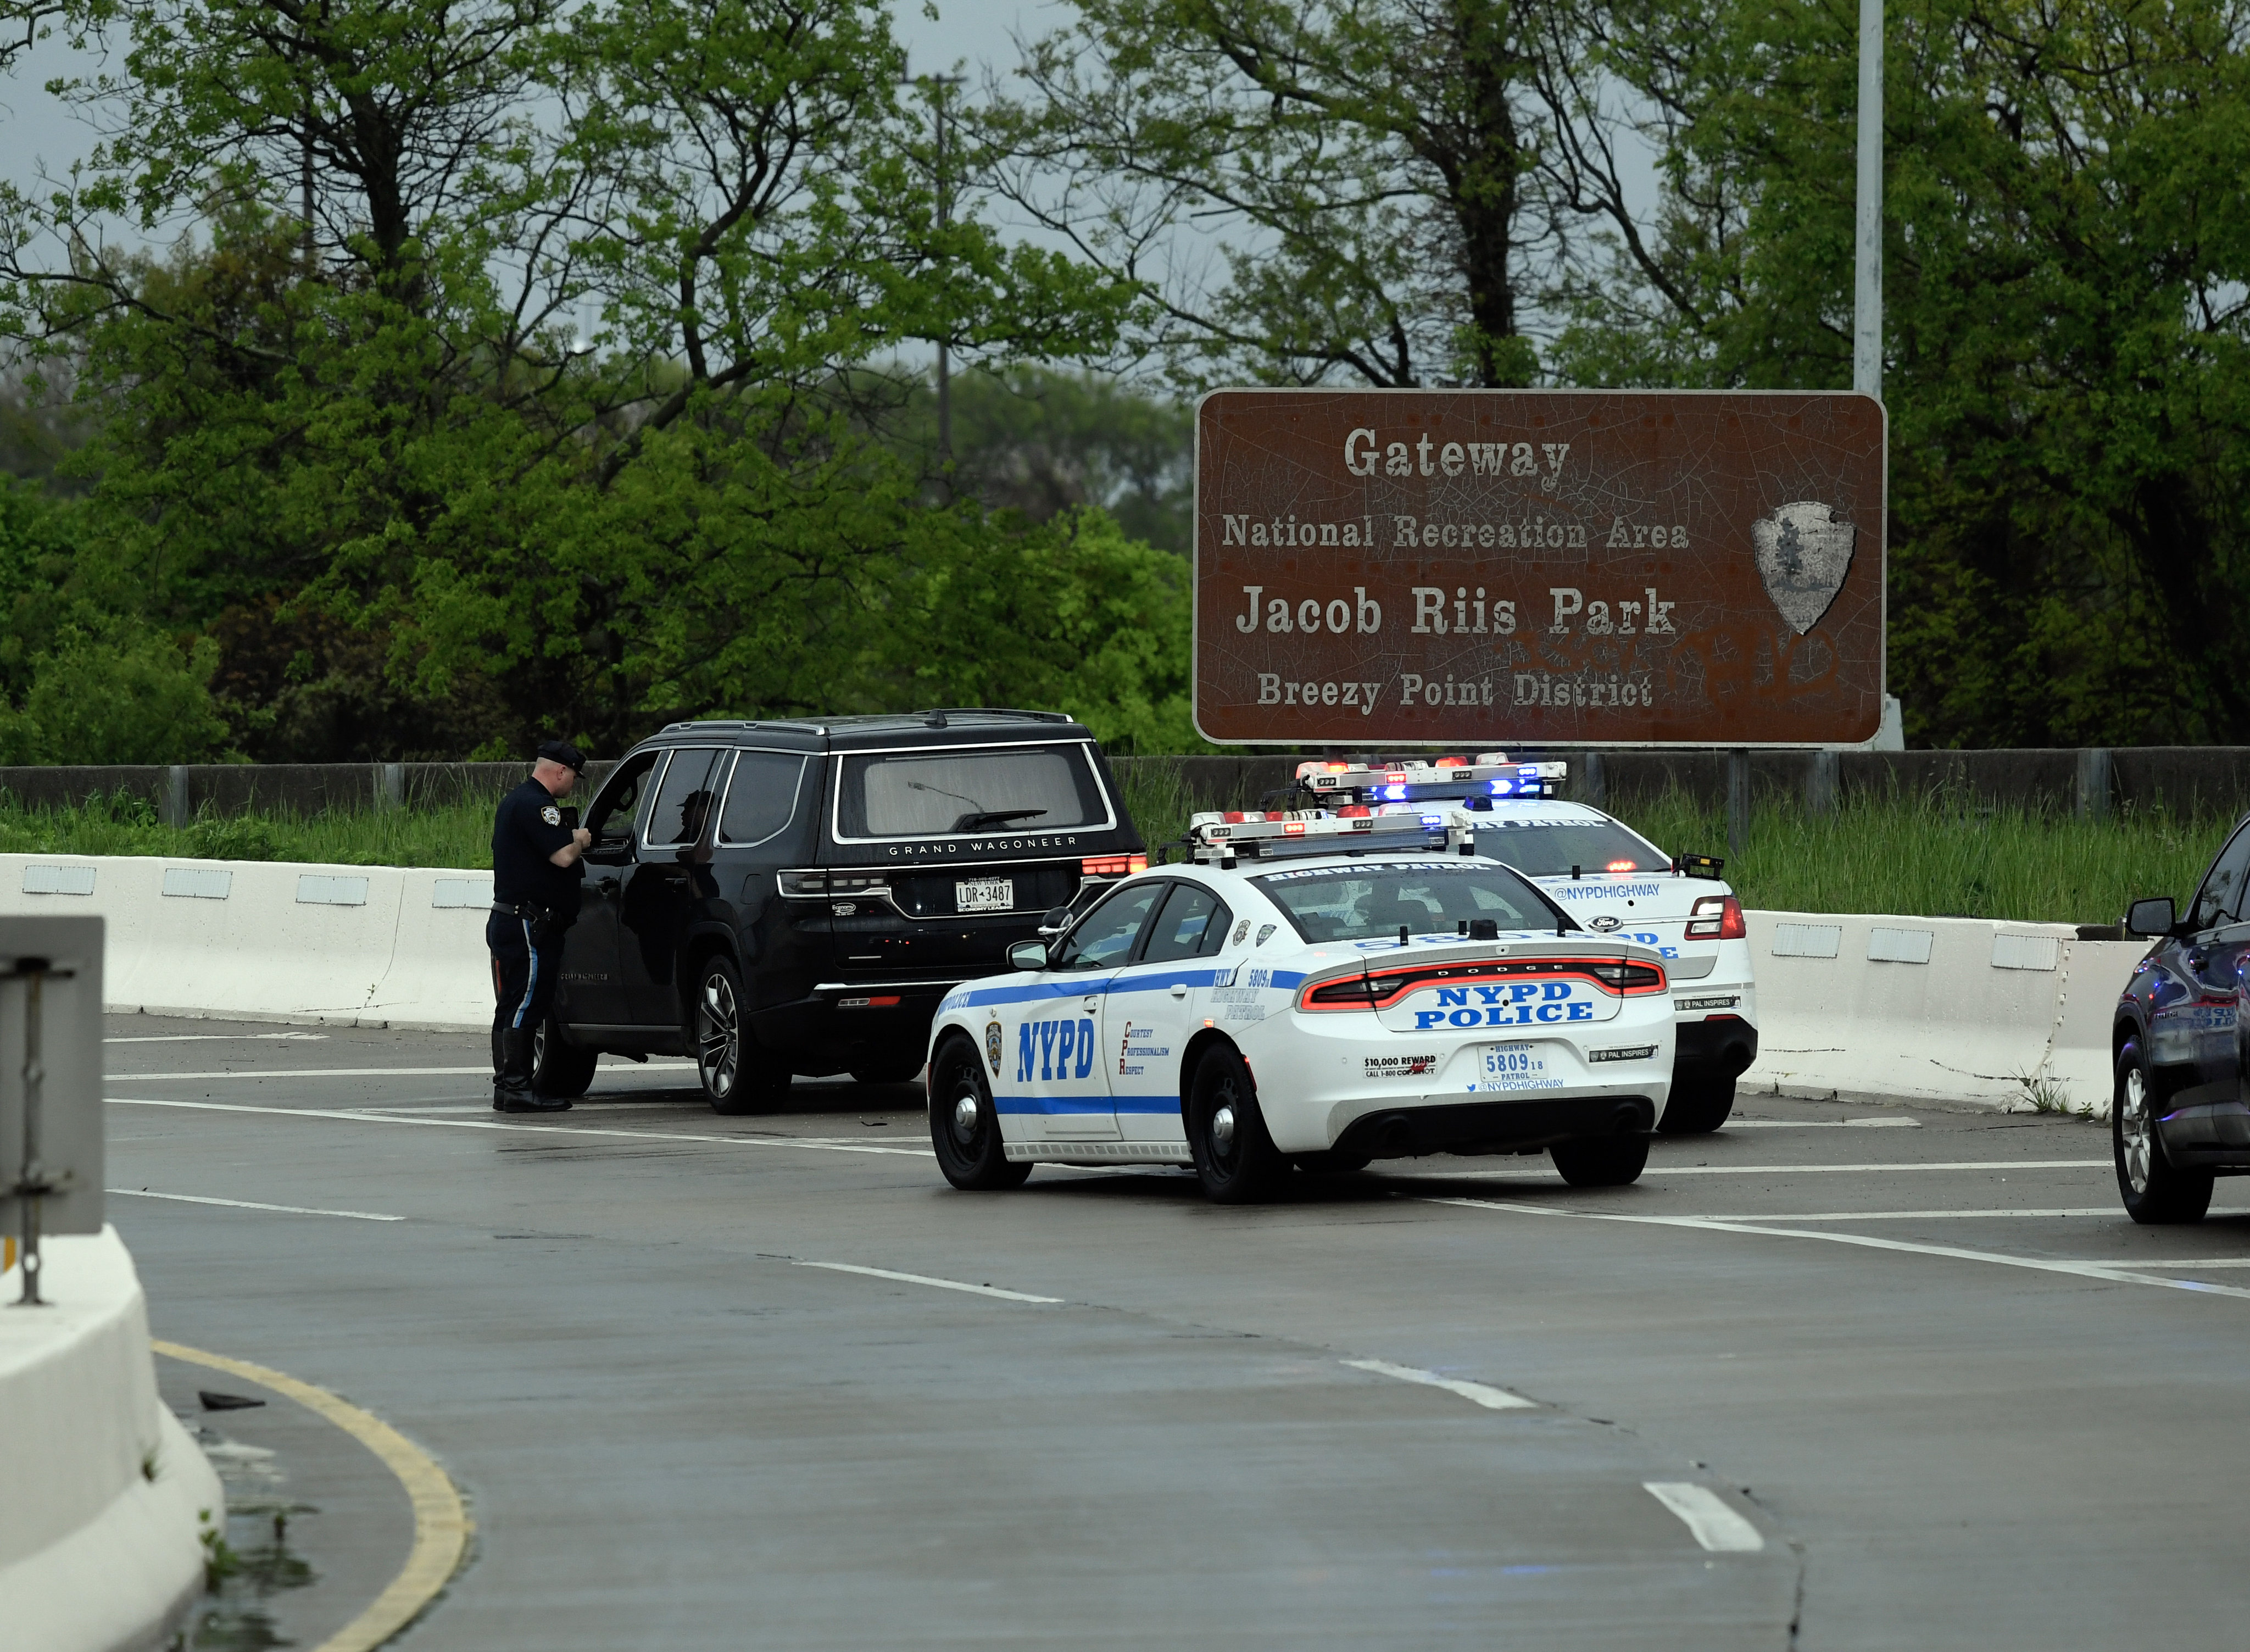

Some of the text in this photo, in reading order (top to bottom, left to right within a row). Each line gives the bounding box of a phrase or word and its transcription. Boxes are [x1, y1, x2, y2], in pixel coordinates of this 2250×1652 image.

[1344, 429, 1570, 492] Gateway
[1222, 514, 1690, 549] National Recreation Area
[1235, 586, 1677, 636] Jacob Riis Park
[1257, 673, 1653, 715] Breezy Point District
[889, 837, 1077, 855] GRAND WAGONEER
[1264, 863, 1491, 882] HIGHWAY PATROL
[959, 885, 1010, 903] LDR 3487
[1555, 883, 1660, 900] @NYPDHIGHWAY
[1597, 917, 1614, 926] Ford
[1248, 969, 1267, 987] 5809
[1437, 965, 1563, 976] DODGE
[1210, 988, 1260, 1003] HIGHWAY
[1436, 982, 1572, 1007] NYPD
[1224, 1005, 1265, 1021] PATROL
[1414, 1002, 1593, 1029] POLICE
[1124, 1021, 1154, 1038] COURTESY
[1017, 1019, 1094, 1082] NYPD
[1121, 1039, 1169, 1056] PROFESSIONALISM
[1495, 1044, 1530, 1053] HIGHWAY
[1621, 1049, 1649, 1058] INSPIRES
[1119, 1058, 1144, 1075] RESPECT
[1365, 1057, 1399, 1067] $10,000
[1401, 1055, 1436, 1065] REWARD
[1486, 1053, 1544, 1072] 5809 18
[1501, 1072, 1530, 1081] PATROL
[1478, 1079, 1564, 1092] @NYPDHIGHWAY
